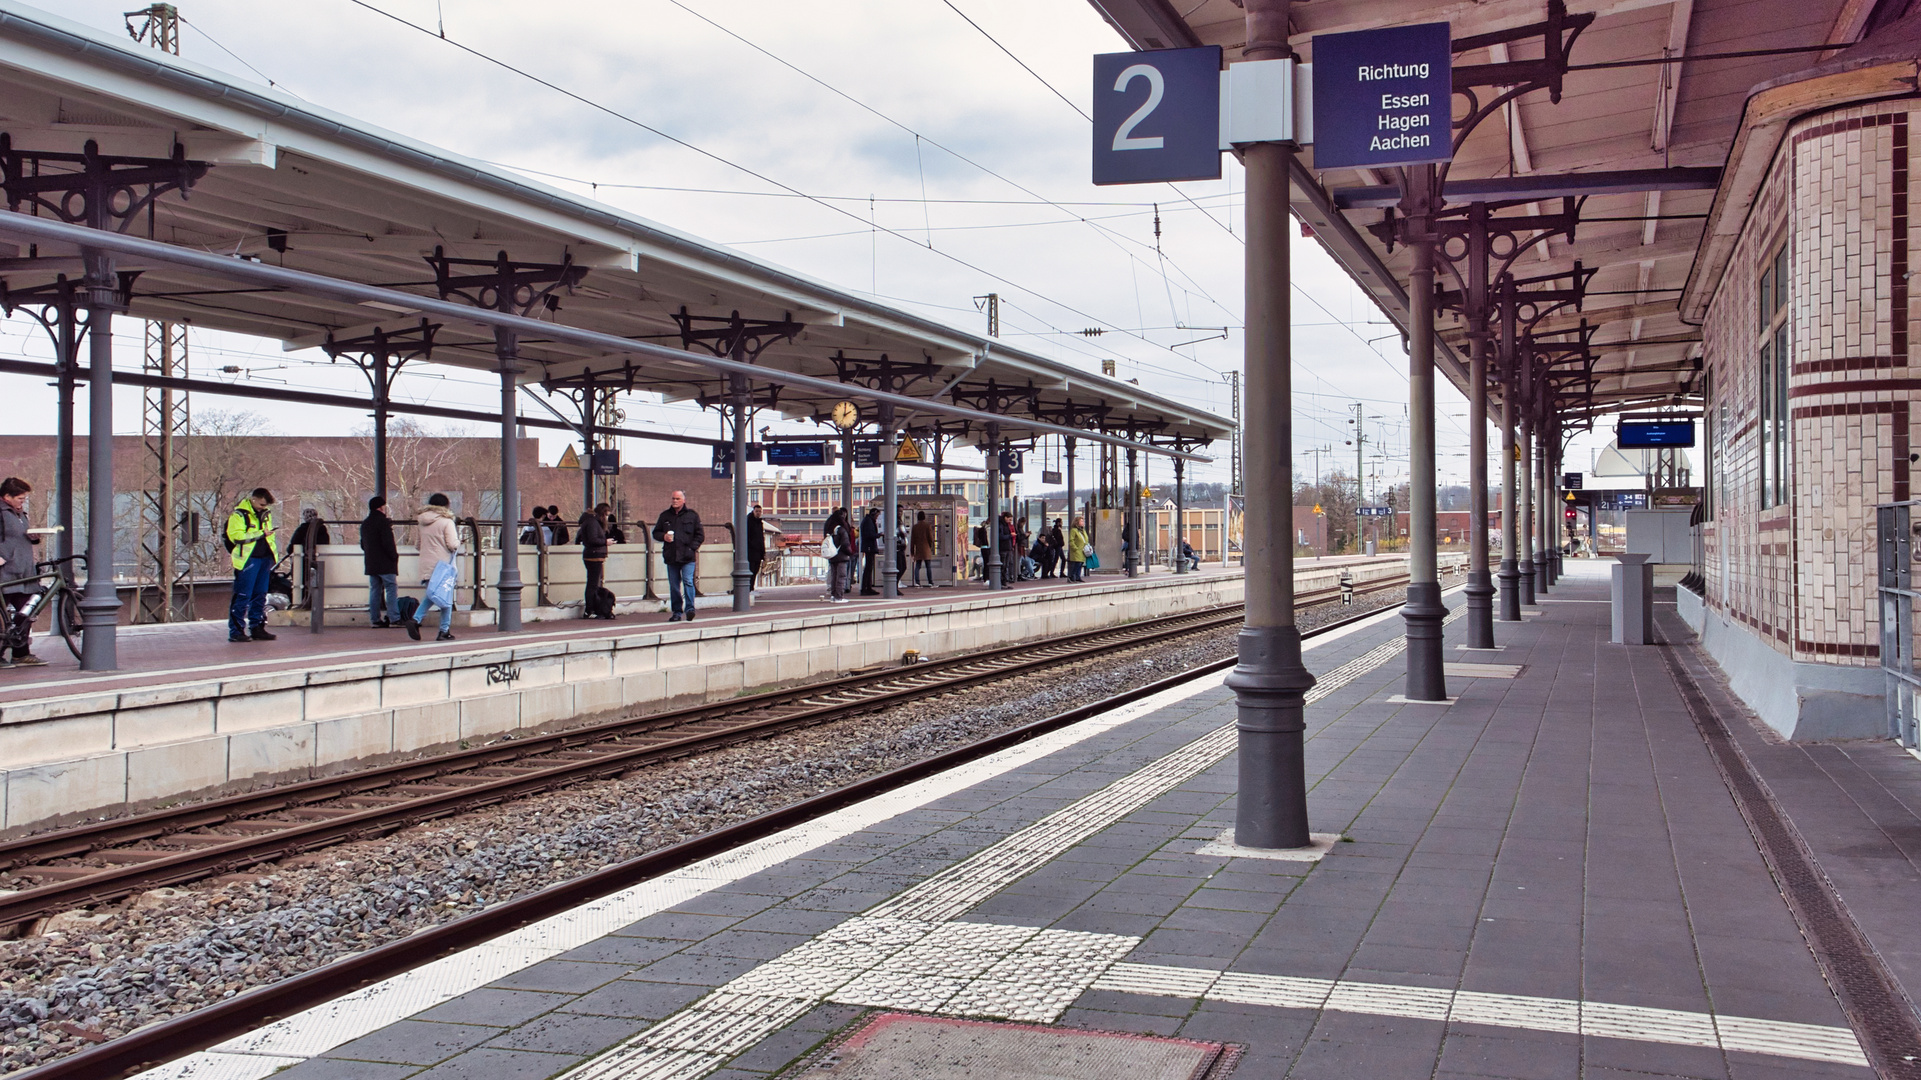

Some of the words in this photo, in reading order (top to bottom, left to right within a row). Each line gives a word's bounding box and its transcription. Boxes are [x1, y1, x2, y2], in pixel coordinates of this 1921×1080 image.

[1358, 61, 1430, 82] Richtung
[1111, 64, 1165, 151] 2
[1381, 92, 1430, 110] Essen
[1377, 113, 1430, 131] Hagen
[1369, 133, 1430, 152] Aachen
[714, 461, 725, 474] 4
[1008, 451, 1020, 469] 3
[1601, 501, 1607, 509] 2
[1342, 593, 1351, 605] H
